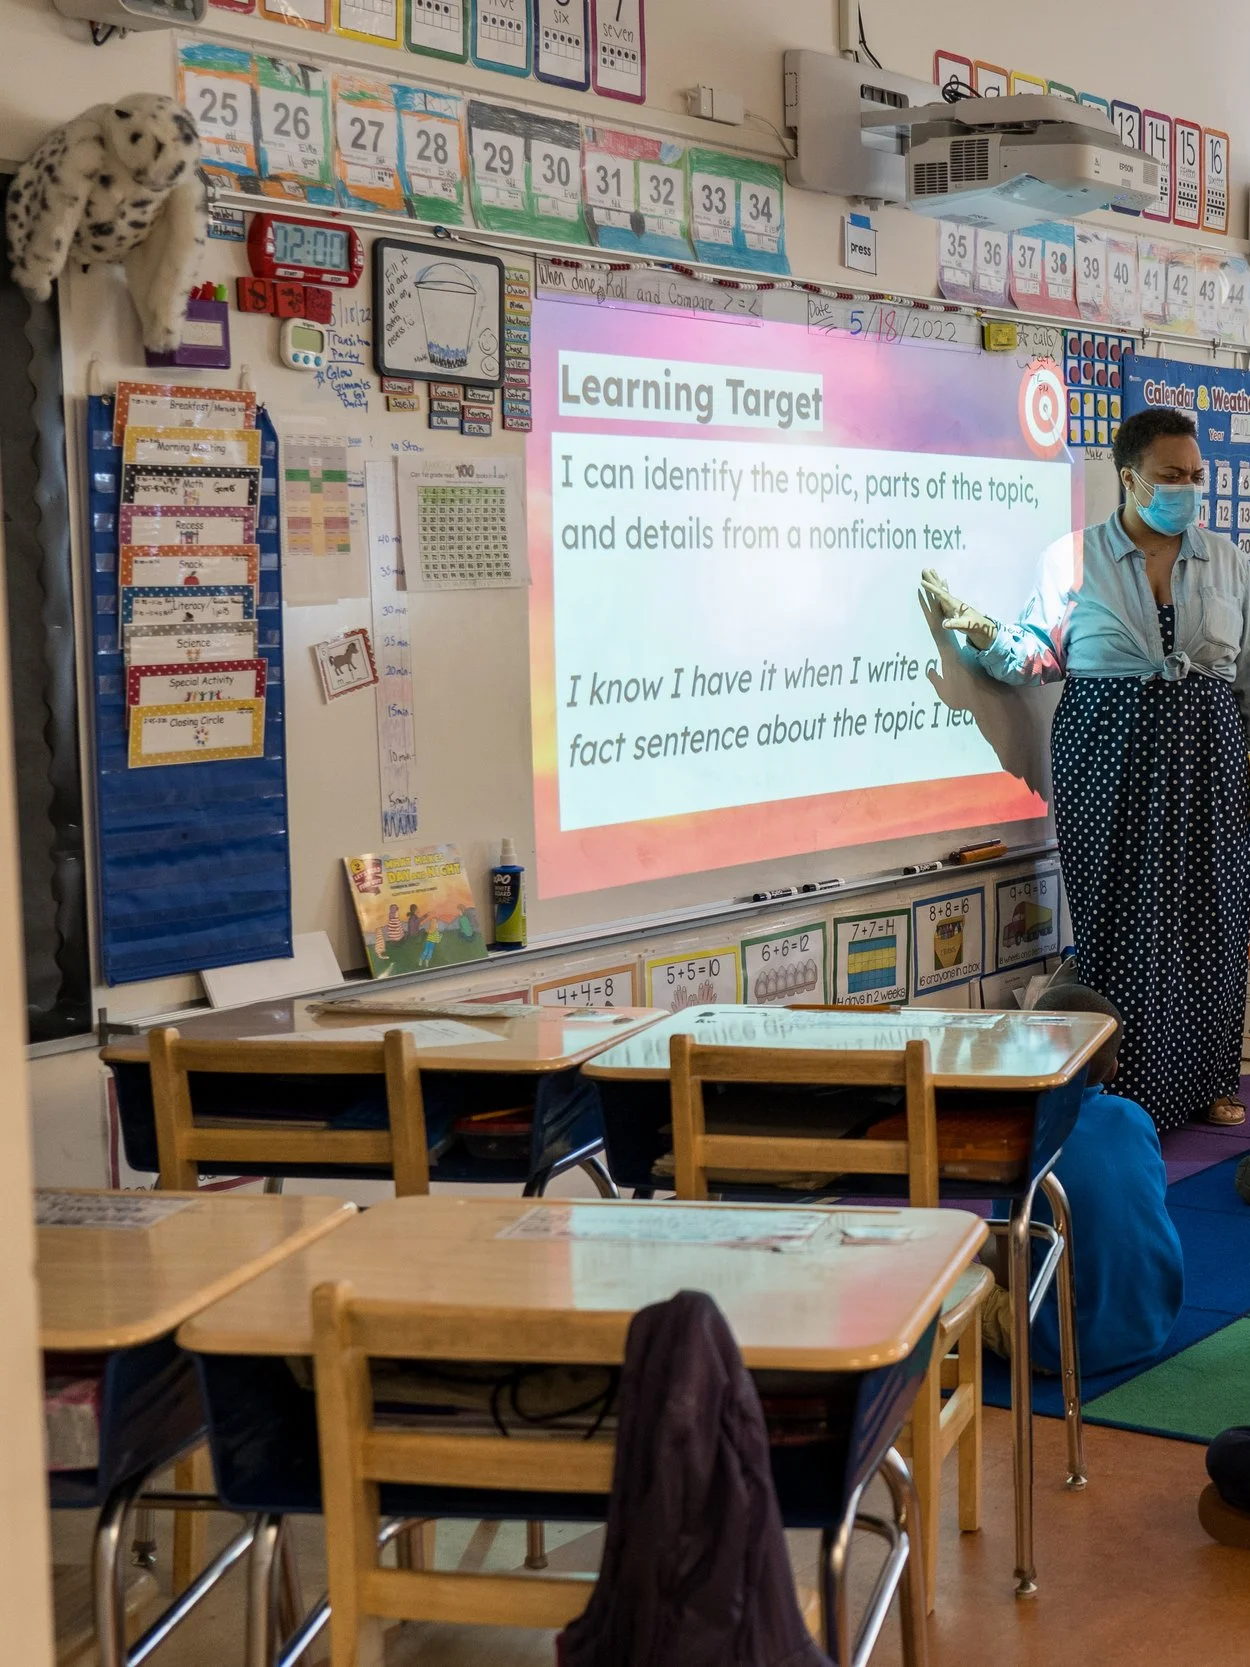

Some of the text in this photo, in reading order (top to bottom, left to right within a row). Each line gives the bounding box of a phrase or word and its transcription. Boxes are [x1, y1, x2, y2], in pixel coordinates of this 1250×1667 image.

[553, 10, 569, 24] six
[602, 22, 634, 43] seven
[200, 88, 238, 127] 25
[273, 102, 310, 140] 26
[350, 117, 384, 152] 27
[416, 129, 448, 164] 28
[1149, 121, 1166, 159] 14
[484, 142, 513, 176] 29
[1180, 130, 1195, 166] 15
[1210, 139, 1222, 174] 16
[542, 153, 570, 186] 30
[1119, 163, 1133, 173] EPSON
[596, 166, 622, 197] 31
[650, 175, 674, 206] 32
[702, 184, 727, 214] 33
[749, 194, 772, 223] 34
[851, 242, 871, 257] press
[947, 233, 967, 259] 35
[984, 240, 1001, 266] 36
[1018, 245, 1036, 269] 37
[1051, 251, 1067, 275] 38
[1083, 257, 1099, 279] 39
[1114, 262, 1129, 285] 40
[538, 263, 715, 317] When Roll and Compare
[1173, 275, 1188, 296] 42
[808, 299, 832, 319] Date
[562, 364, 822, 429] Learning Target
[1144, 379, 1195, 409] Calendar
[1197, 385, 1210, 410] &
[1209, 428, 1225, 441] Year
[157, 443, 226, 455] Morning Mting
[183, 478, 203, 488] Math
[561, 455, 1039, 509] I can identify the topic, parts of the topic,
[1221, 473, 1227, 488] 5
[1243, 474, 1249, 490] 6
[176, 520, 204, 530] Recess
[1219, 506, 1229, 522] 12
[1240, 507, 1250, 523] 13
[561, 515, 966, 550] and details from a nonfiction text.
[176, 639, 211, 648] Science
[169, 676, 234, 688] Special Activity
[567, 675, 581, 708] I
[589, 672, 664, 706] know
[671, 667, 684, 699] I
[691, 665, 752, 697] have
[760, 660, 777, 692] it
[784, 658, 843, 689] when
[850, 656, 861, 684] I
[868, 652, 919, 683] write
[170, 715, 224, 728] Closing Circle
[570, 732, 626, 768] fact
[633, 725, 749, 760] sentence
[757, 712, 826, 746] about
[833, 707, 867, 738] the
[874, 701, 925, 740] topic
[931, 702, 941, 728] I
[384, 857, 412, 869] WHAT
[388, 869, 412, 883] DAY
[425, 862, 461, 878] NIGHT
[926, 969, 956, 983] crayons
[969, 961, 980, 972] box
[881, 987, 906, 1000] weeks
